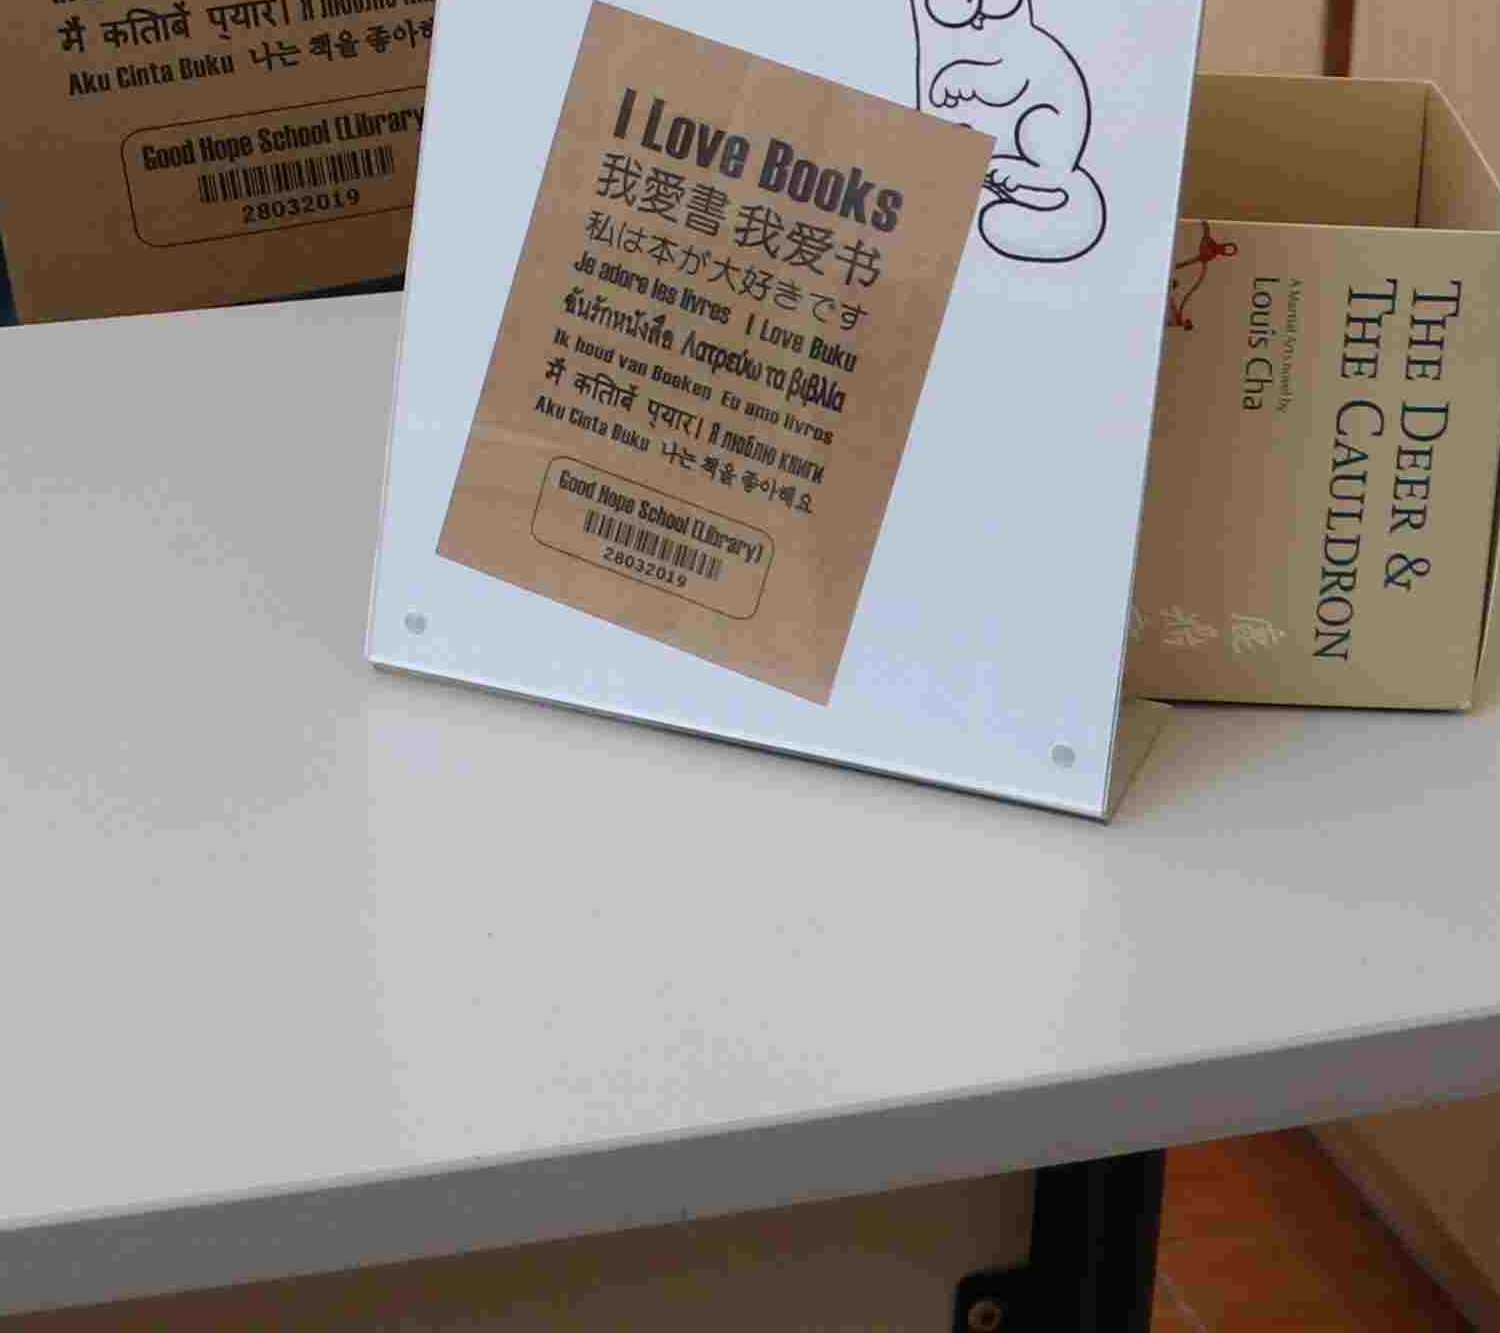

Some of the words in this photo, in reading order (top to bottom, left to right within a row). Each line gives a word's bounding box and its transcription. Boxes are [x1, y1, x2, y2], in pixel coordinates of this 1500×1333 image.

[141, 138, 196, 171] Good
[198, 135, 254, 163] Hope
[257, 118, 331, 153] School
[613, 87, 637, 139] I
[640, 97, 750, 179] Love
[757, 138, 902, 232] Books
[241, 189, 361, 224] 28032019
[1248, 277, 1280, 350] Louis
[1340, 278, 1398, 379] THE
[1405, 280, 1462, 381] THE
[1242, 357, 1273, 410] Cha
[1389, 402, 1450, 533] DEER
[602, 546, 687, 587] 28032019
[1311, 400, 1385, 662] CAULDRON
[1383, 552, 1431, 591] &
